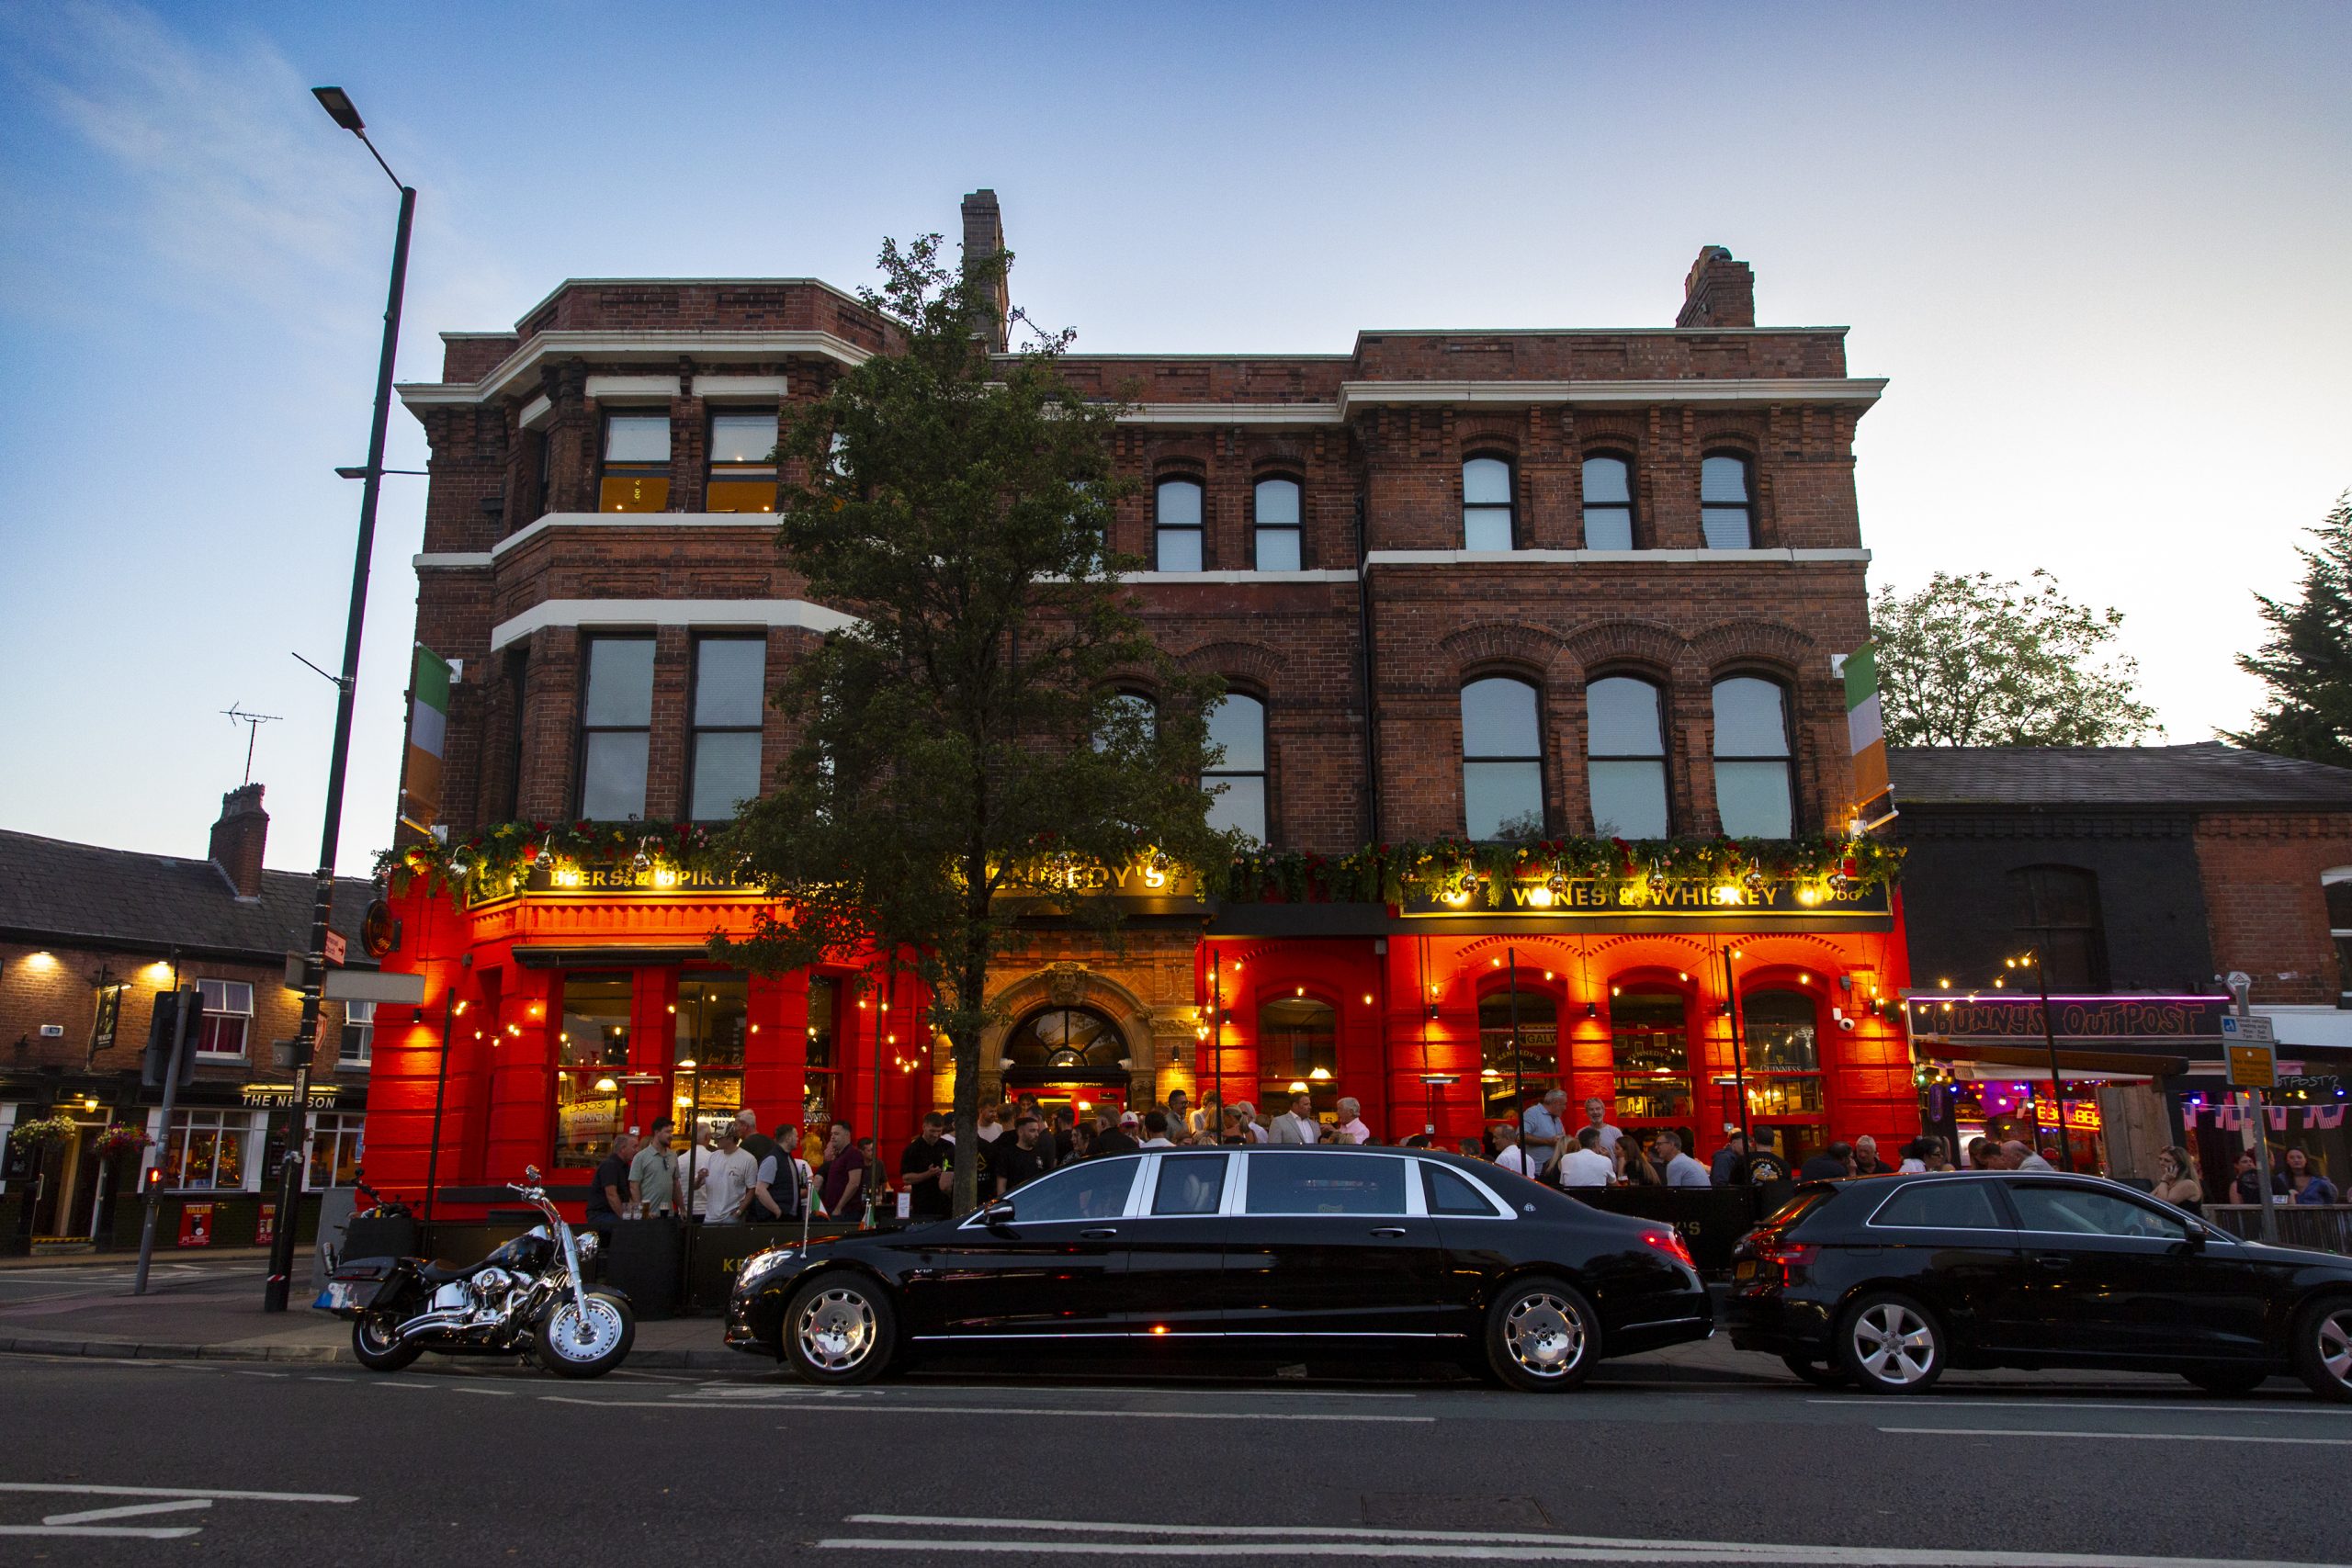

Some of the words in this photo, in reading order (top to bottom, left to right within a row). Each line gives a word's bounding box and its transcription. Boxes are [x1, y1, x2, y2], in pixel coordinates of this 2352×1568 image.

[550, 870, 624, 886] BEERS
[1512, 887, 1607, 906] WINES
[1653, 887, 1778, 906] WHISKEY
[243, 1094, 271, 1106] THE
[276, 1096, 335, 1109] NESON
